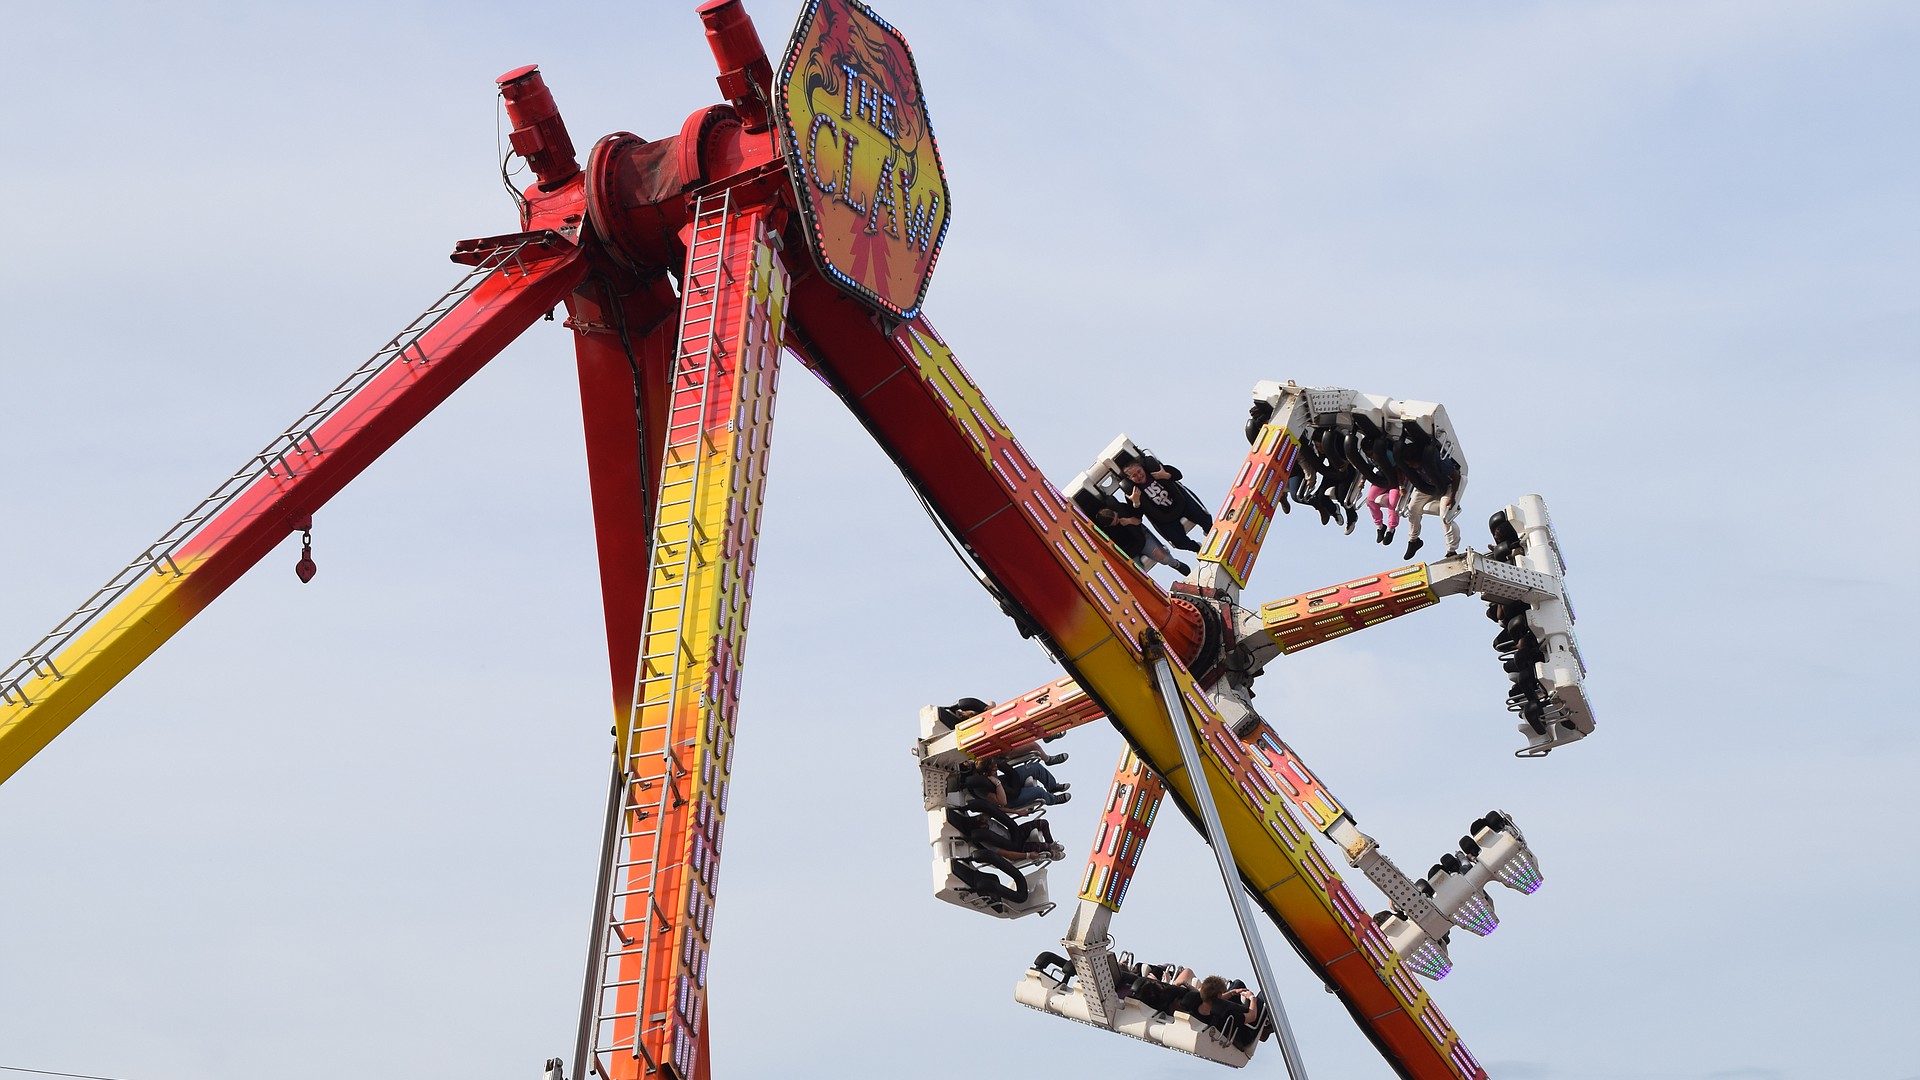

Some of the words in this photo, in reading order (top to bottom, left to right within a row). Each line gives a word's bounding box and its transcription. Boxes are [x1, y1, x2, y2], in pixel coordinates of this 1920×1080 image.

[841, 64, 896, 139] THE
[806, 113, 939, 257] CLAW
[1144, 480, 1164, 498] UST
